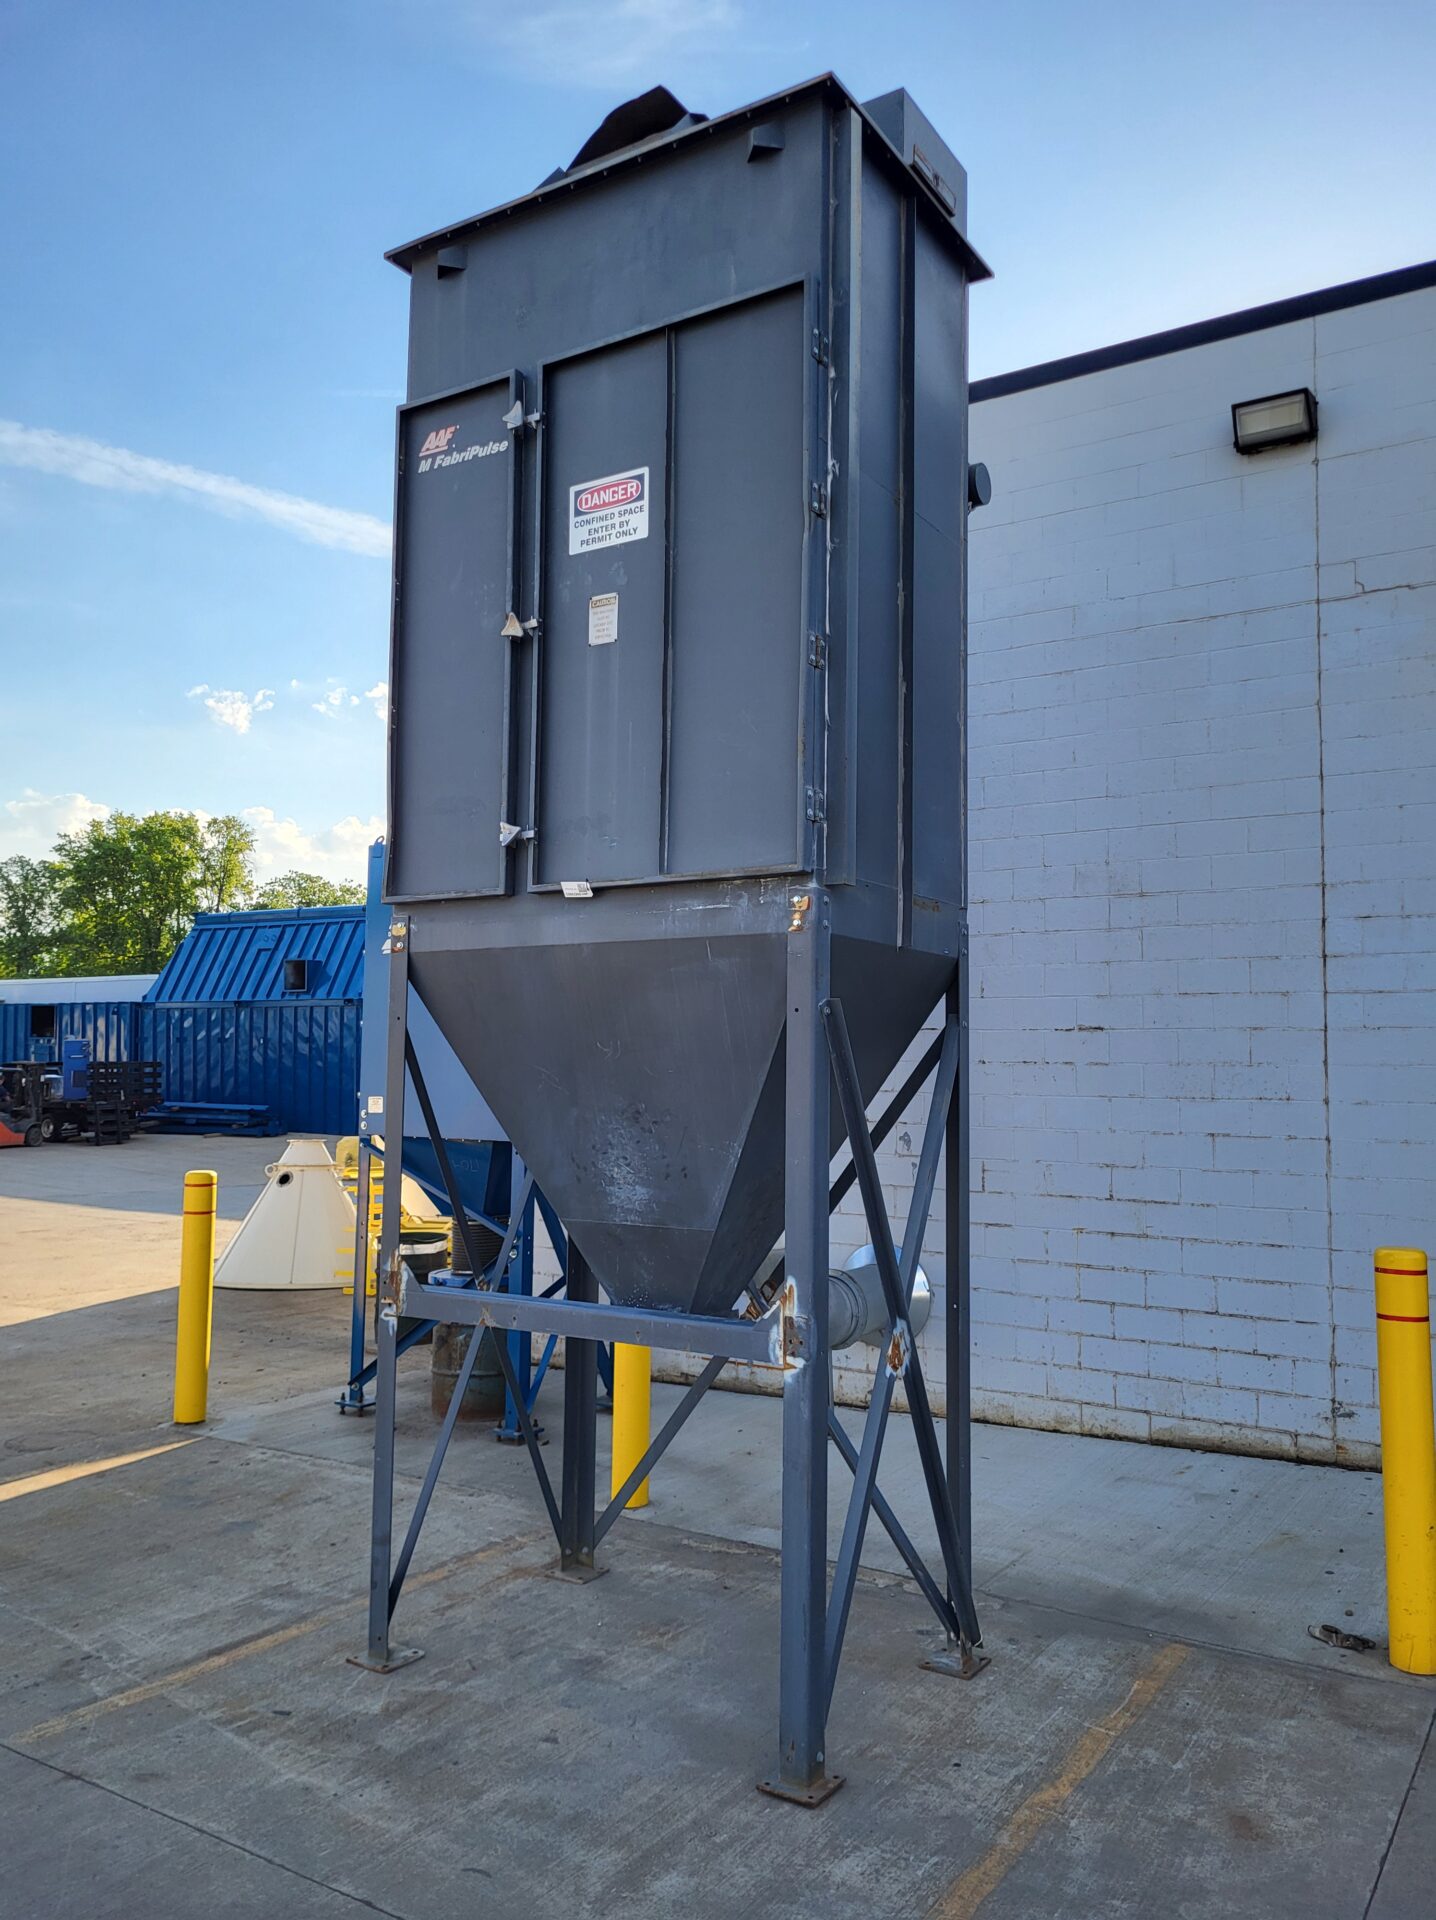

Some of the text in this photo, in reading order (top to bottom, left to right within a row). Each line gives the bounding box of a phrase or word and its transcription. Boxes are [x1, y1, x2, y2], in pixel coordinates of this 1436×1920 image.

[420, 426, 456, 454] AAF
[418, 440, 509, 474] M FabriPulse
[581, 482, 637, 509] DANGER
[574, 504, 645, 529] CONFINED SPACE
[588, 519, 631, 537] ENTER BY
[580, 526, 639, 548] PERMIT ONLY
